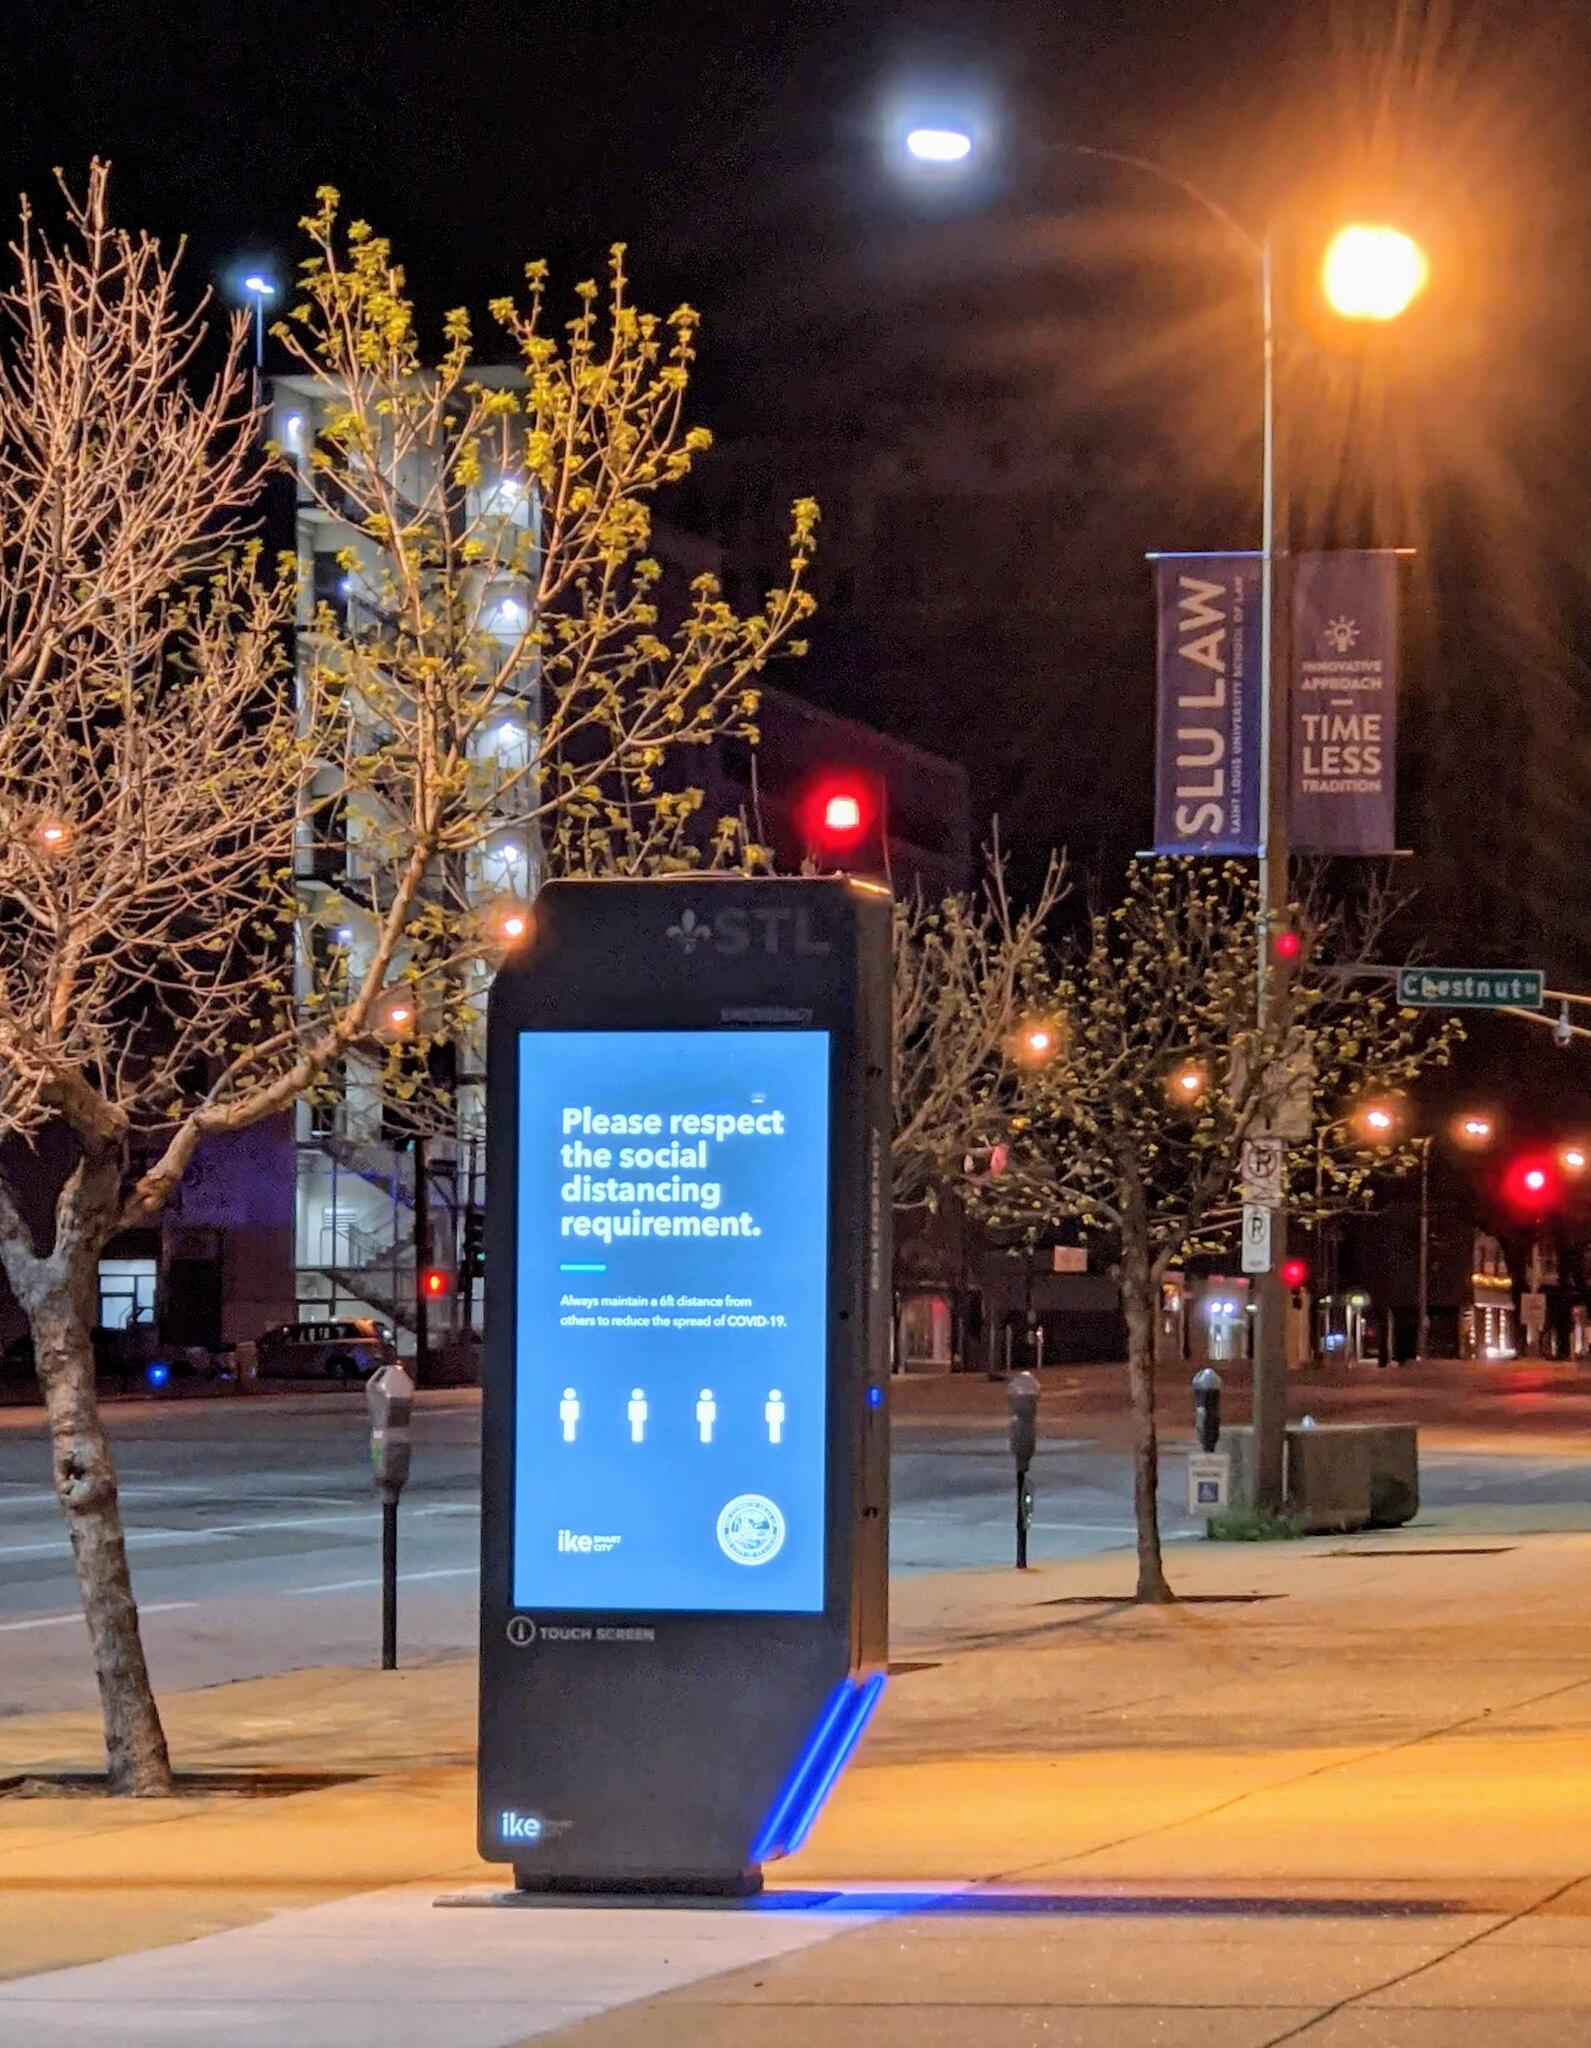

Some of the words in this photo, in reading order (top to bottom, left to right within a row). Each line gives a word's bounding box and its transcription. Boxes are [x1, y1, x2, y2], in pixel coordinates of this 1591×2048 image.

[1233, 606, 1244, 623] OF
[1178, 576, 1227, 708] LAW
[1233, 628, 1244, 678] SCHOOL
[1301, 677, 1382, 690] APPROACH
[1231, 682, 1243, 754] UNIVERSITY
[1301, 714, 1382, 741] TIME
[1302, 745, 1382, 775] LESS
[1175, 727, 1226, 835] SLU
[1231, 757, 1242, 795] LOUIS
[1302, 779, 1381, 793] TRADITION
[1230, 798, 1241, 834] SAINT
[714, 906, 831, 955] STL
[1403, 975, 1521, 998] Chestnut
[562, 1106, 662, 1135] Please
[669, 1110, 785, 1142] respect
[560, 1140, 612, 1168] the
[618, 1140, 707, 1168] social
[560, 1174, 721, 1209] distancing
[560, 1208, 762, 1244] requirement.
[560, 1294, 599, 1309] Always
[601, 1295, 648, 1307] maintain
[650, 1298, 658, 1307] a
[659, 1294, 674, 1307] 6ft
[676, 1295, 723, 1307] distance
[725, 1294, 752, 1307] from
[560, 1314, 596, 1326] others
[597, 1315, 610, 1326] to
[611, 1314, 650, 1326] reduce
[652, 1314, 671, 1326] the
[672, 1315, 711, 1328] spread
[713, 1315, 726, 1327] of
[727, 1315, 788, 1327] COVID-19.
[558, 1528, 593, 1552] ike
[540, 1626, 592, 1640] TOUCH
[596, 1627, 656, 1641] SCREEN
[502, 1811, 541, 1837] ike
